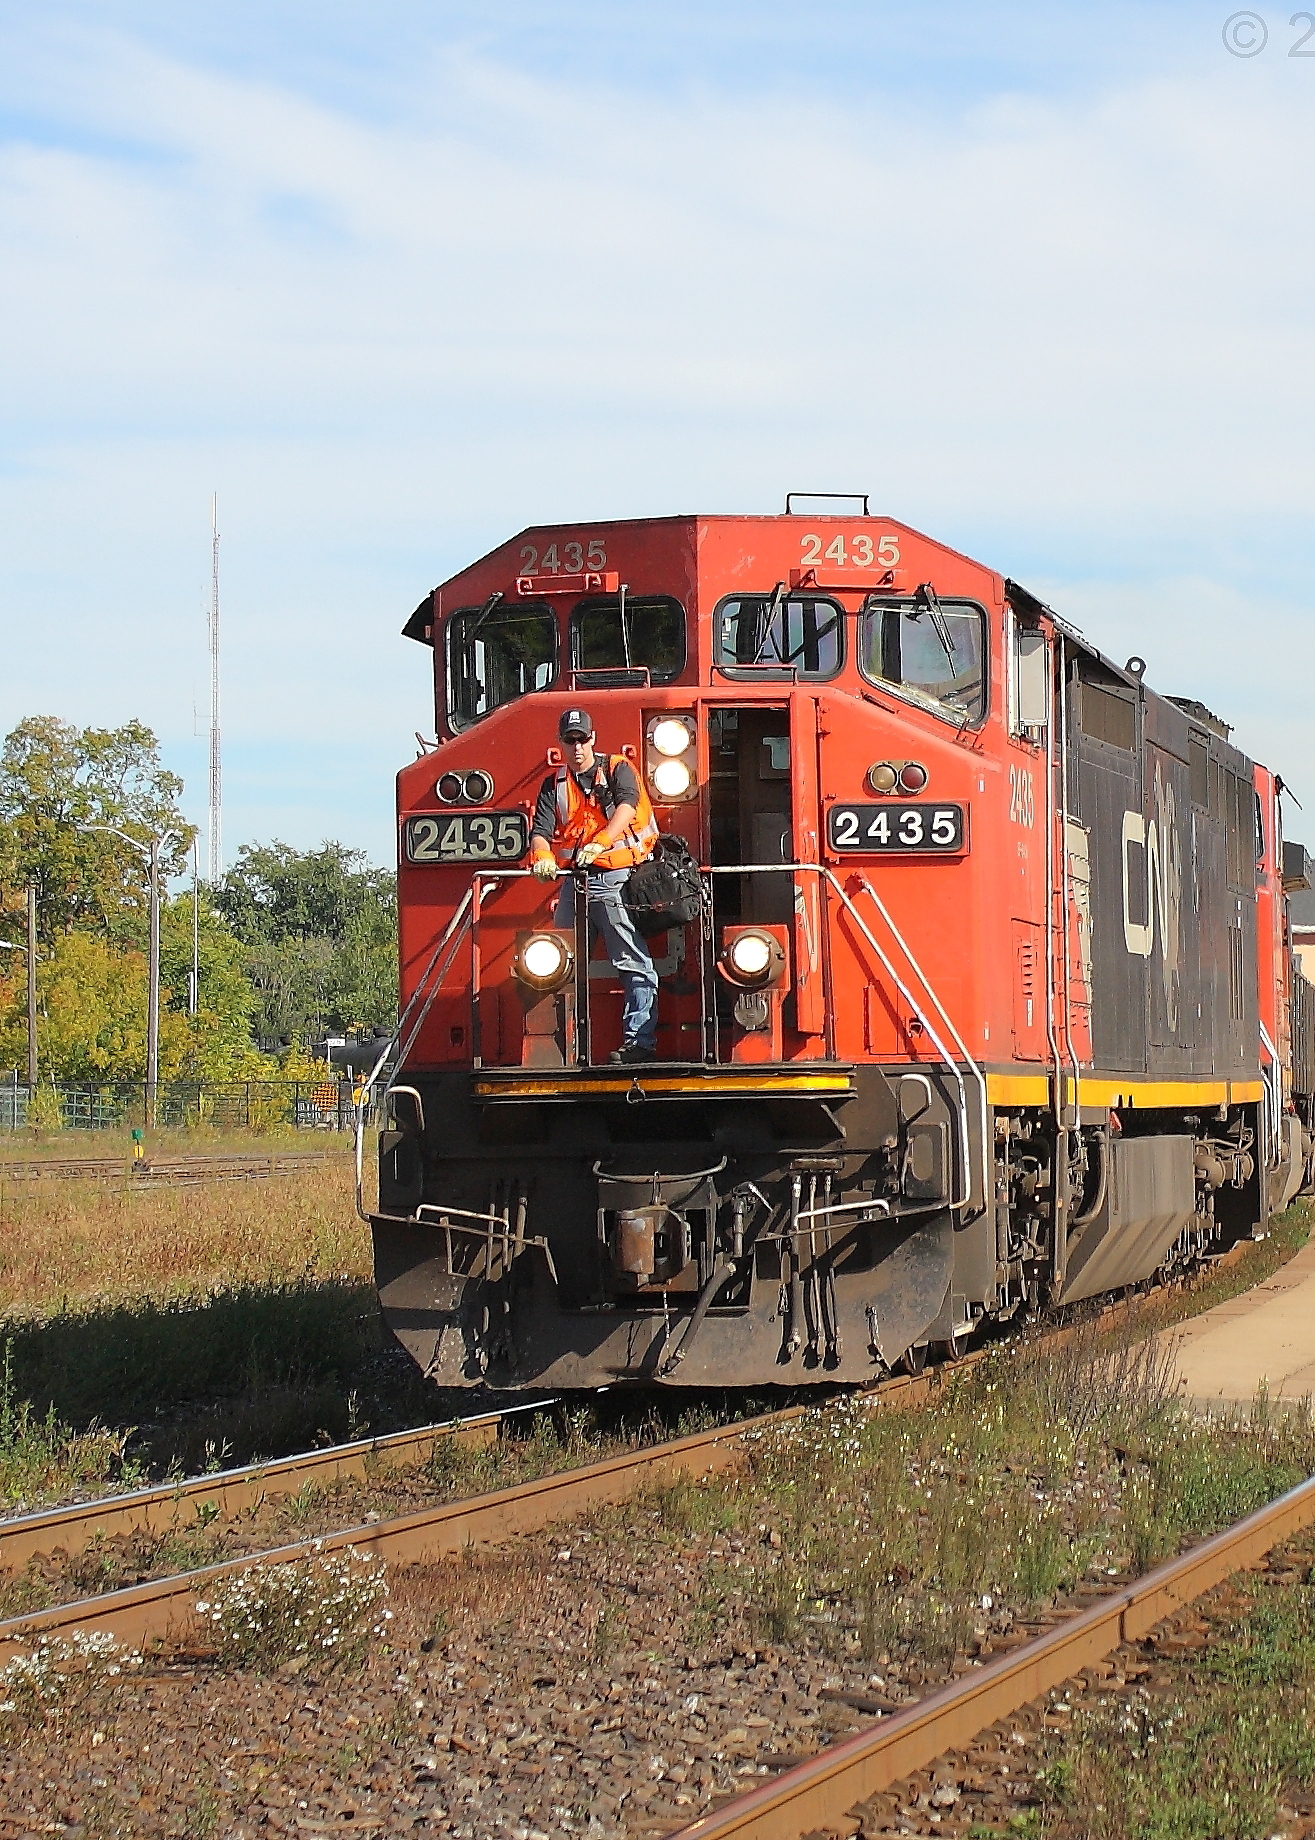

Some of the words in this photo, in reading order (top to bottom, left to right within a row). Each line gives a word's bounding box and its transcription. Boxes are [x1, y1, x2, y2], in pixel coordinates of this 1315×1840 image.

[519, 540, 607, 575] 2435
[800, 533, 900, 567] 2435
[1009, 763, 1034, 829] 2435
[413, 816, 522, 859] 2435
[835, 811, 956, 845] 2435
[1122, 810, 1168, 961] CN
